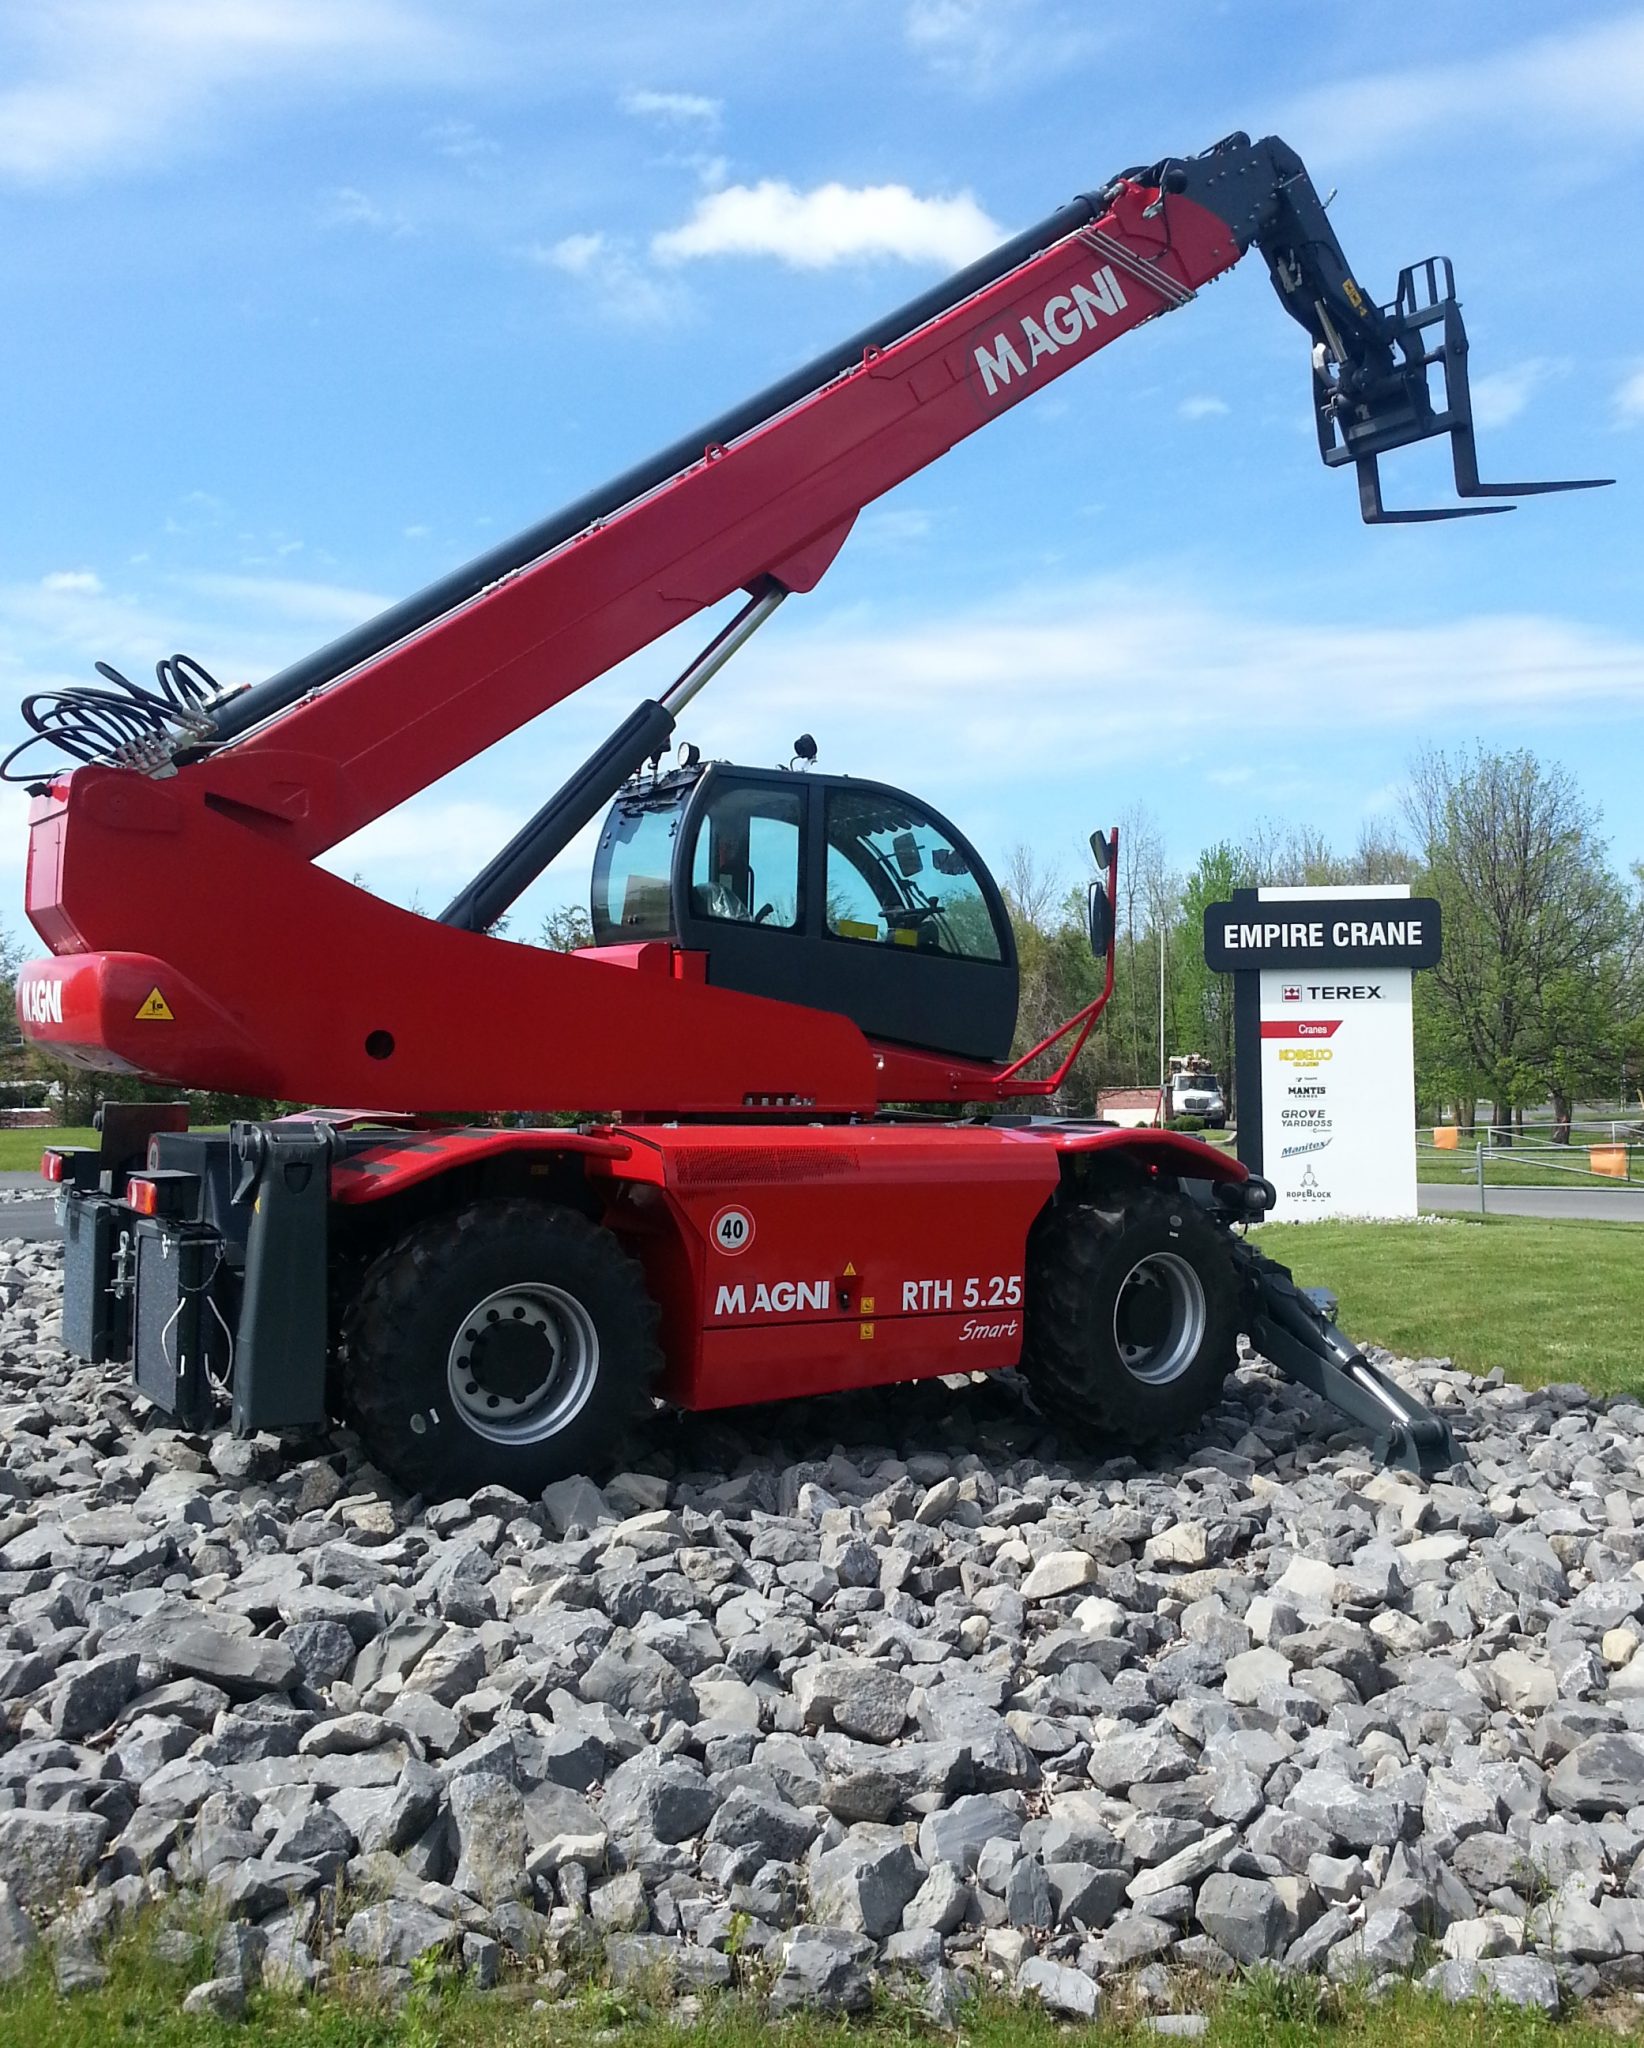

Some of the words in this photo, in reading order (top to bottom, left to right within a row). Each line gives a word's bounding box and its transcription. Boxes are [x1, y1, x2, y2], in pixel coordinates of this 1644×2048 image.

[974, 265, 1128, 396] MAGNI
[1224, 923, 1324, 948] EMPIRE
[1332, 921, 1422, 947] CRANE
[22, 979, 63, 1023] MAGNI
[1307, 986, 1382, 1000] TEREX
[1298, 1024, 1328, 1034] Cranes
[1288, 1086, 1326, 1094] MANTIS
[1281, 1109, 1326, 1119] GROVE
[1281, 1119, 1333, 1127] YARDBOSS
[721, 1219, 744, 1239] 40
[714, 1280, 830, 1315] MAGNI
[902, 1279, 952, 1311] RTH
[963, 1276, 1021, 1308] 5.25
[958, 1319, 1018, 1341] Smart
